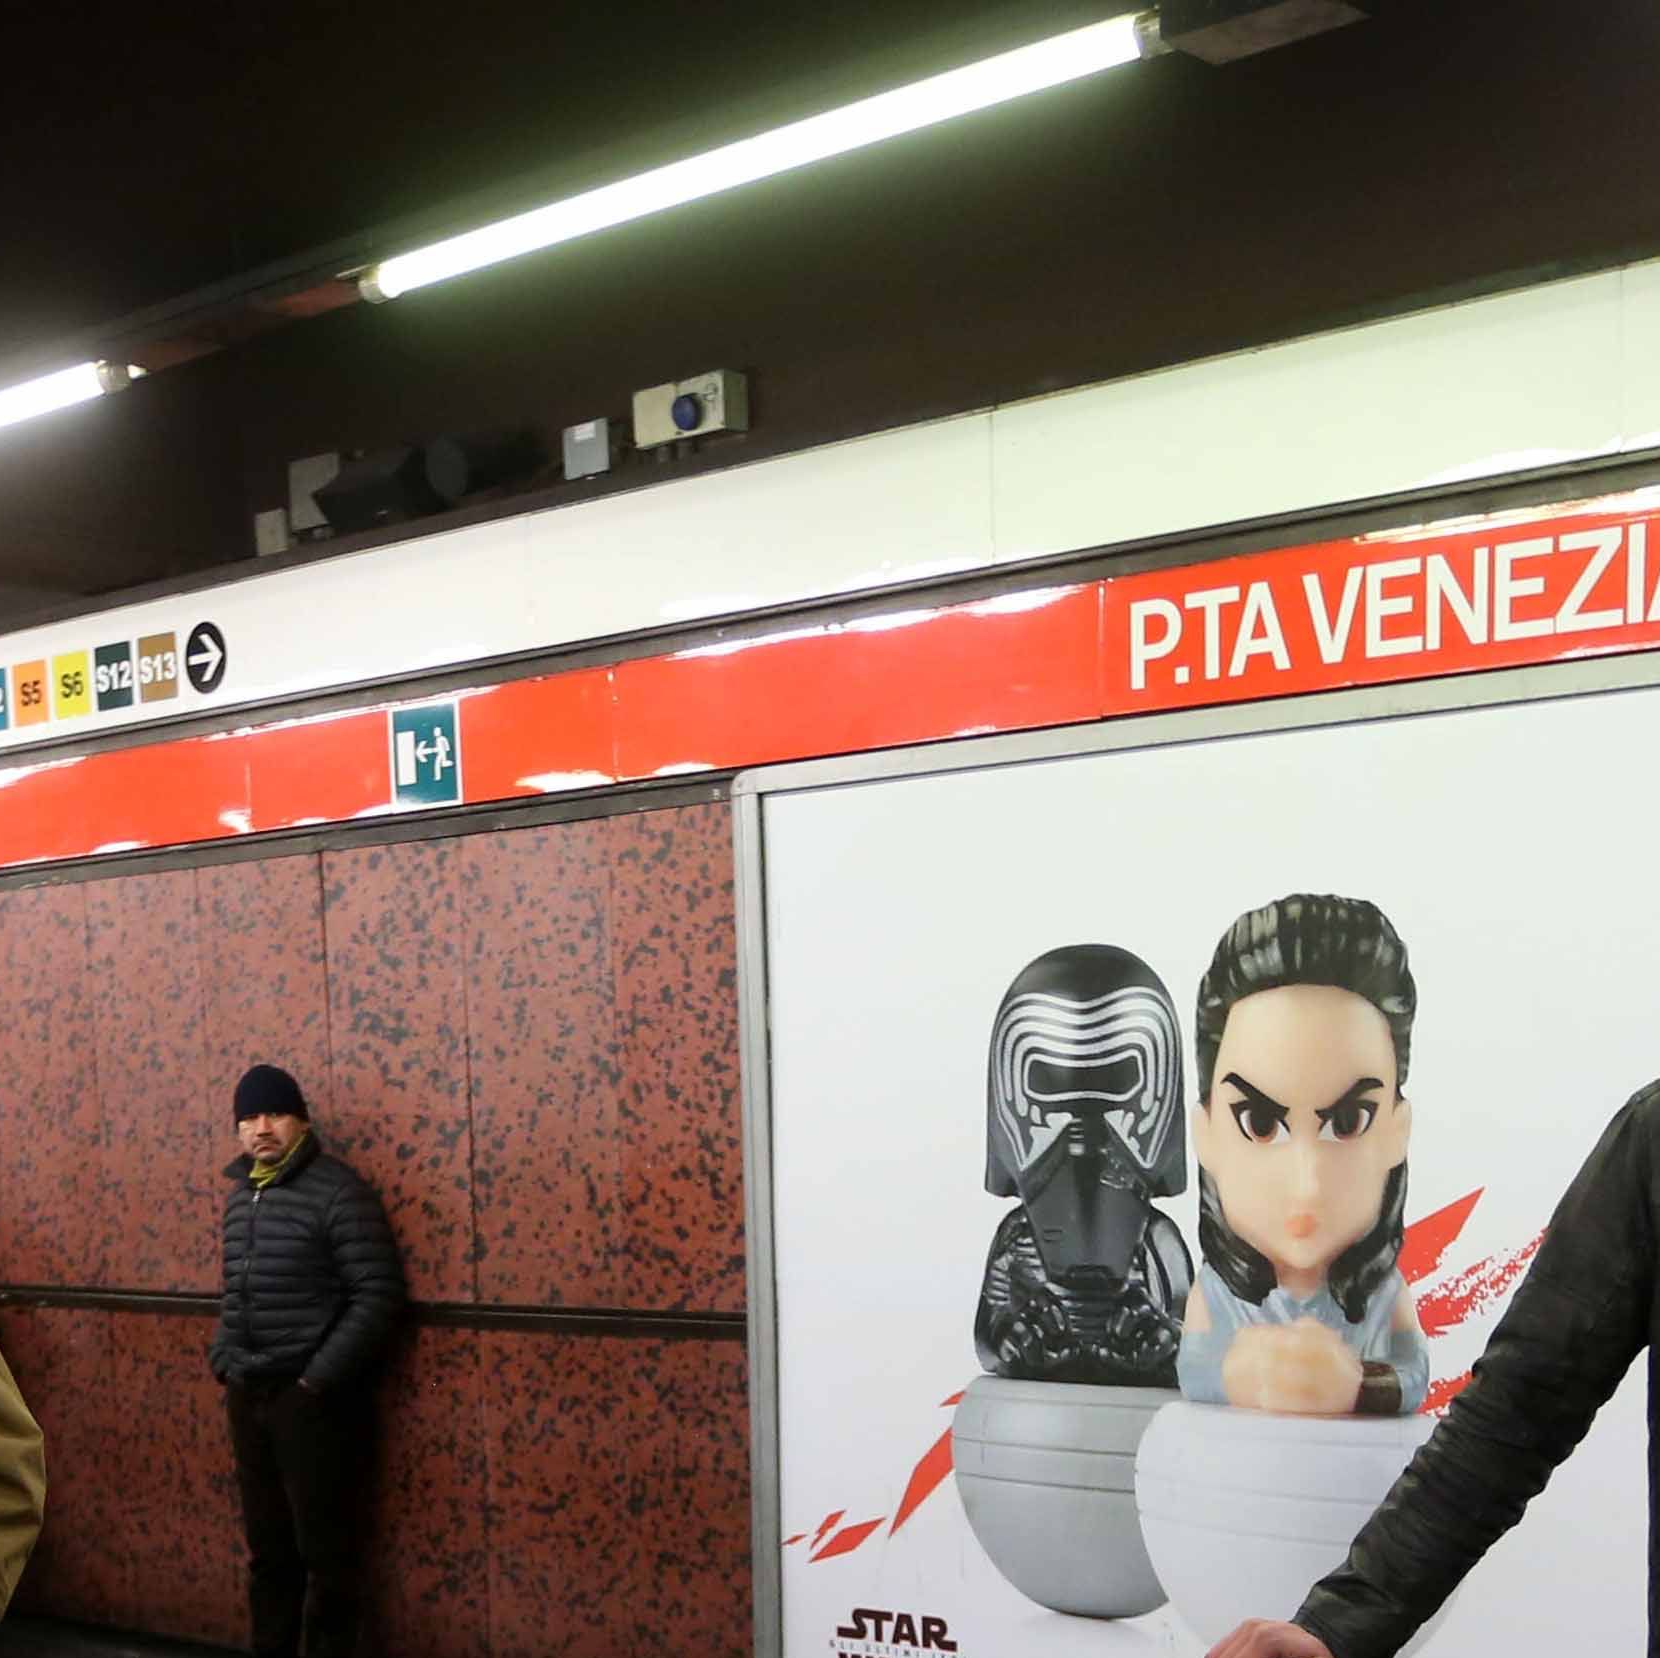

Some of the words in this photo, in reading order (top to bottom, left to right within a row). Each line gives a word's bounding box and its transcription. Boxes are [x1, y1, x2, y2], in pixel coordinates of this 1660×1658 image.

[1130, 581, 1292, 690] P.TA
[21, 679, 41, 706] S5
[61, 671, 84, 699] S6
[96, 660, 133, 693] S12
[139, 651, 176, 685] S13
[836, 1608, 958, 1652] STAR
